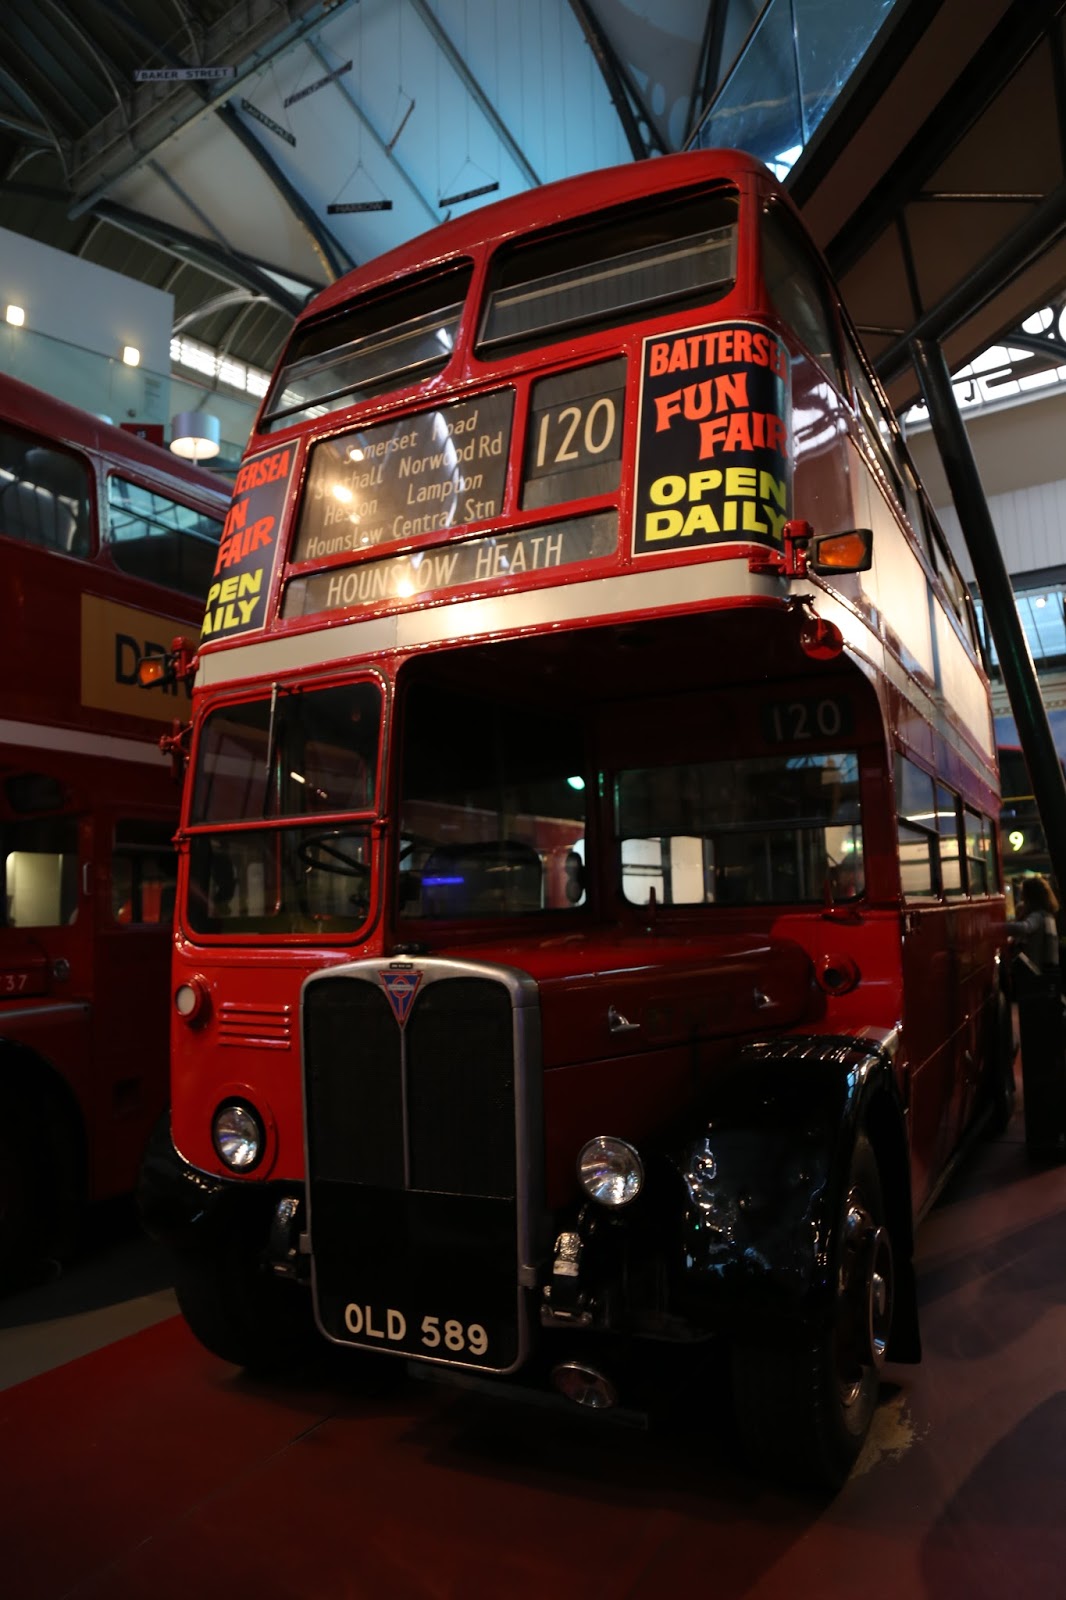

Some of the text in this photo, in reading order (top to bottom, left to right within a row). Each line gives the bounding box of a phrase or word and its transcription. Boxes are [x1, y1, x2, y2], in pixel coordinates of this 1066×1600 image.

[142, 68, 229, 80] BAKER STREET
[654, 371, 750, 433] FUN
[344, 431, 418, 464] Smerset
[537, 398, 615, 467] 120
[698, 411, 788, 461] FAIR
[315, 431, 503, 499] Sthall Norwood Rd
[407, 474, 483, 505] Lampton
[649, 467, 787, 511] OPEN
[305, 527, 383, 559] Hounslow
[464, 498, 495, 522] Stn
[645, 500, 787, 542] DAILY
[213, 515, 276, 577] FAIR
[475, 534, 563, 578] HEATH
[205, 568, 264, 612] PEN
[773, 699, 841, 743] 120
[1008, 830, 1024, 851] 9
[344, 1302, 488, 1356] OLD 589
